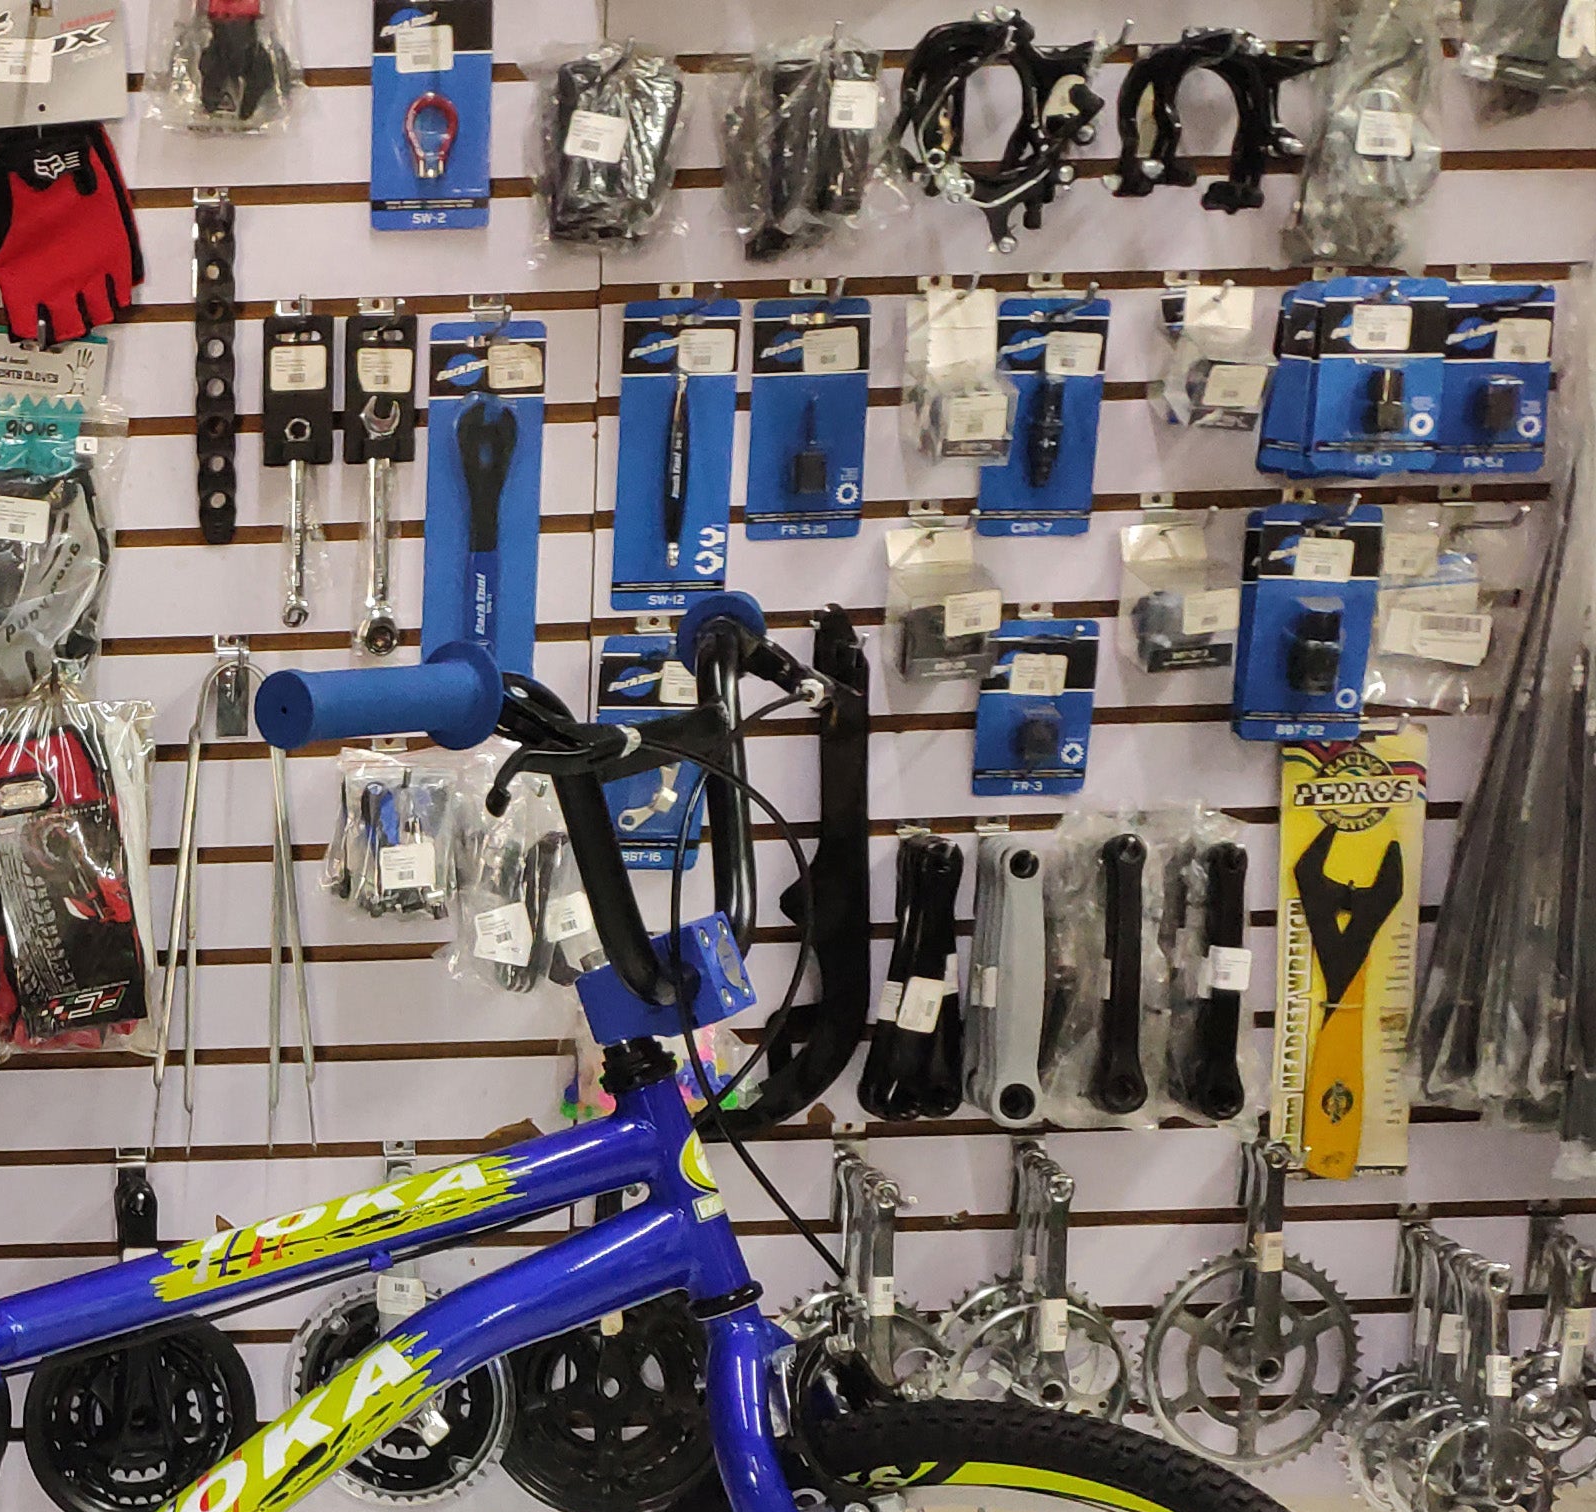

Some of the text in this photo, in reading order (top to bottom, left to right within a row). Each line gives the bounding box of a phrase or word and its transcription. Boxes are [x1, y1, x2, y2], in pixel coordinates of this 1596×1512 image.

[412, 213, 447, 225] SW-2
[84, 443, 90, 451] L
[648, 595, 685, 605] SW-12
[1012, 781, 1043, 791] FR-3
[1282, 1000, 1306, 1089] HEADSET
[192, 1159, 494, 1285] TOKA
